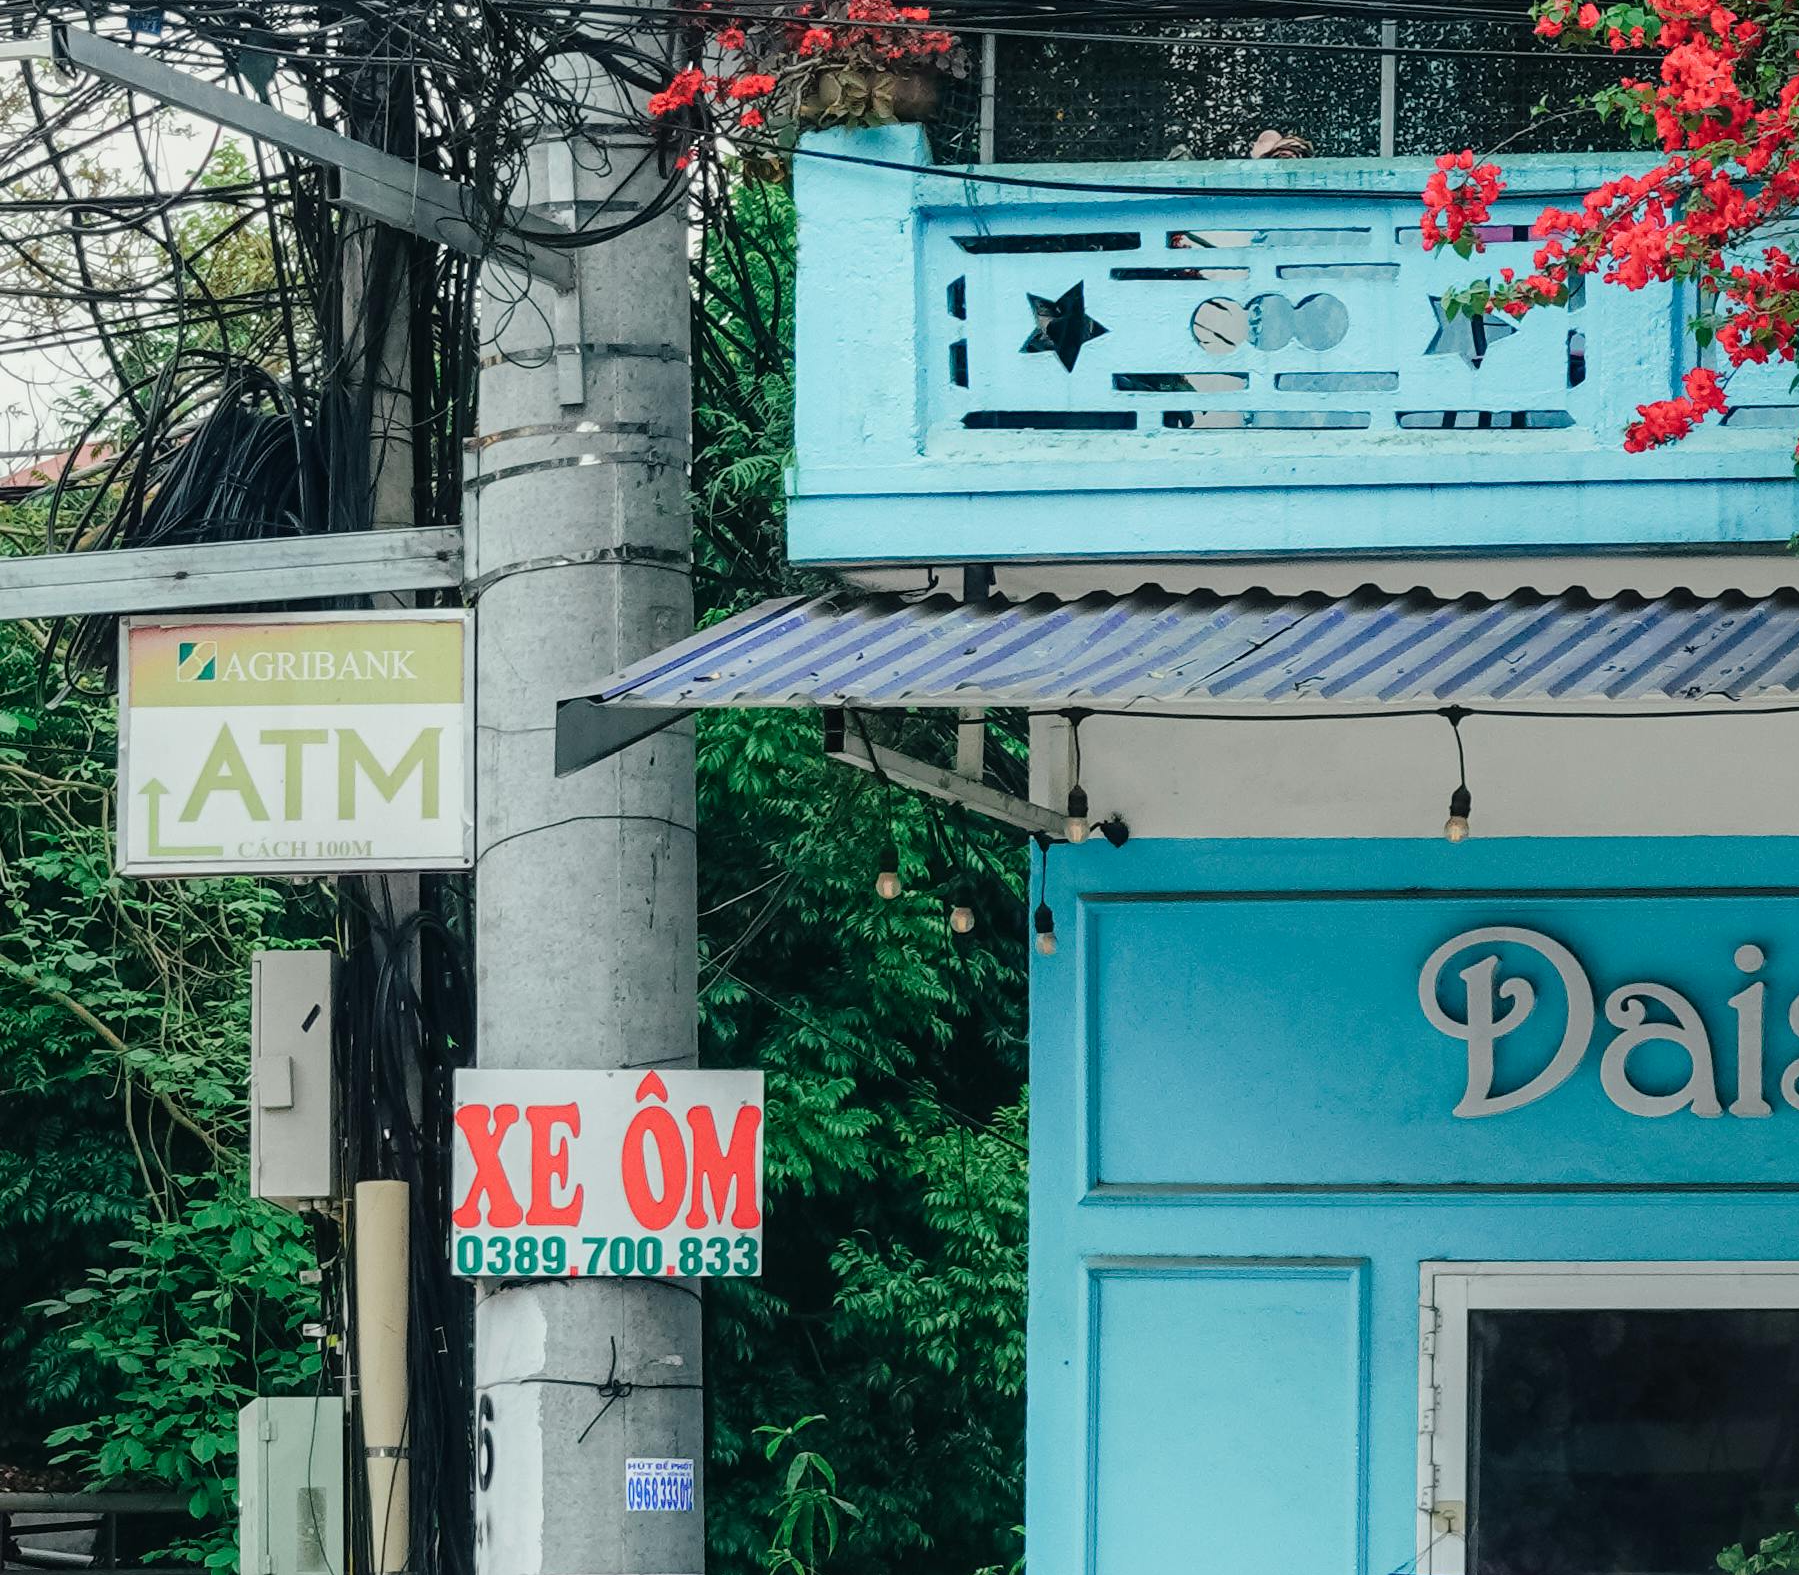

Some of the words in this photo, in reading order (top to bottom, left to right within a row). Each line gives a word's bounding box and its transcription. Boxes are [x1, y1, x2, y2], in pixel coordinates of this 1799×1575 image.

[222, 649, 418, 682] AGRIBANK
[178, 721, 445, 823] ATM
[237, 837, 308, 859] CÁCH
[315, 839, 375, 858] 100M
[452, 1101, 584, 1229] XE
[621, 1069, 762, 1231] ÔM
[456, 1234, 759, 1276] 0389.700.833
